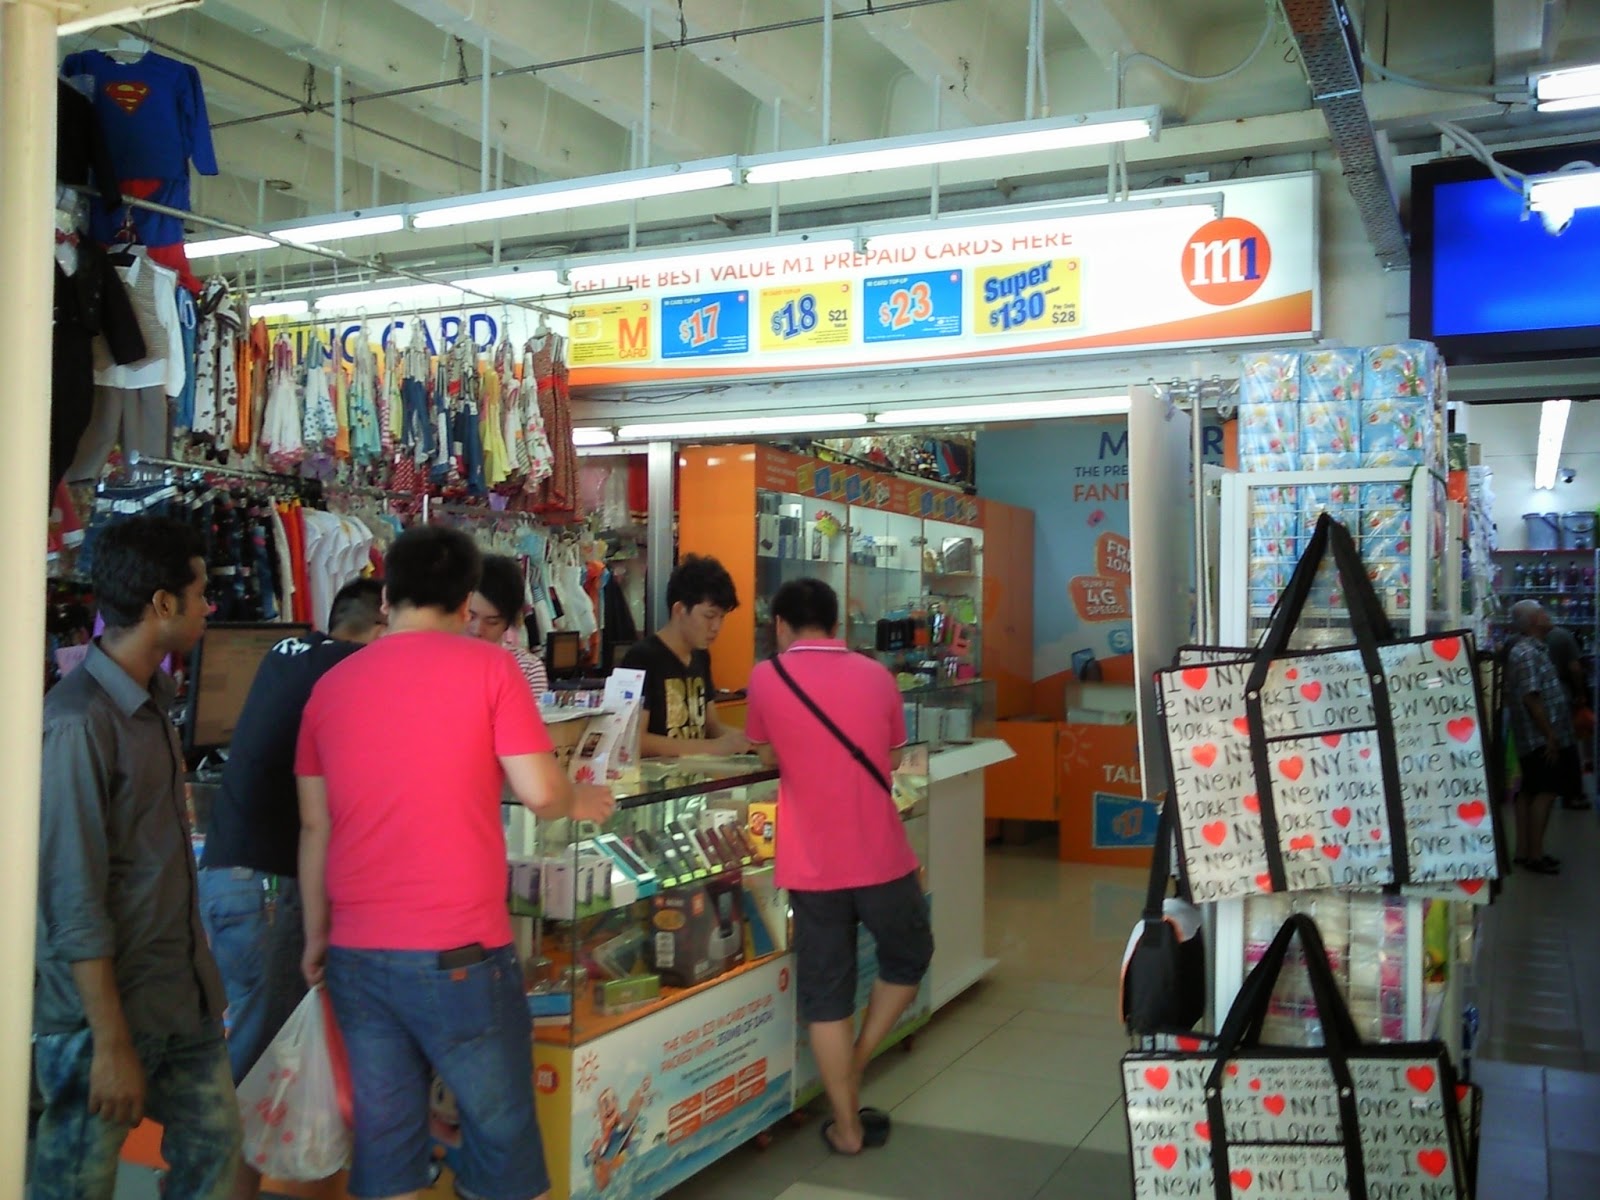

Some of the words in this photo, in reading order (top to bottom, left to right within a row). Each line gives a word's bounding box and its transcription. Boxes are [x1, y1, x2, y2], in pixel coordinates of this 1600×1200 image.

[617, 273, 651, 290] THE
[657, 267, 700, 287] BEST
[711, 259, 776, 282] VALUE
[782, 256, 815, 274] M1
[823, 246, 916, 271] PREPAID
[924, 237, 1003, 259] CARDS
[1011, 232, 1073, 251] HERE
[984, 260, 1052, 303] Super
[771, 294, 818, 340] $18
[828, 309, 849, 322] $21
[879, 281, 933, 331] $23
[989, 291, 1045, 331] $130
[1052, 310, 1076, 324] $28
[381, 313, 498, 357] CARD
[618, 316, 648, 350] M
[679, 302, 720, 348] $17
[618, 348, 648, 359] CARD
[1074, 465, 1101, 478] THE
[1103, 463, 1130, 477] PRE
[1073, 481, 1130, 503] FANT
[1087, 589, 1117, 606] 4G
[1214, 662, 1245, 689] NY
[1325, 678, 1351, 701] NY
[1102, 764, 1142, 784] TAL
[1309, 751, 1342, 779] NY
[1355, 804, 1382, 827] NY
[1175, 1066, 1207, 1091] NY
[1258, 1169, 1285, 1192] NY
